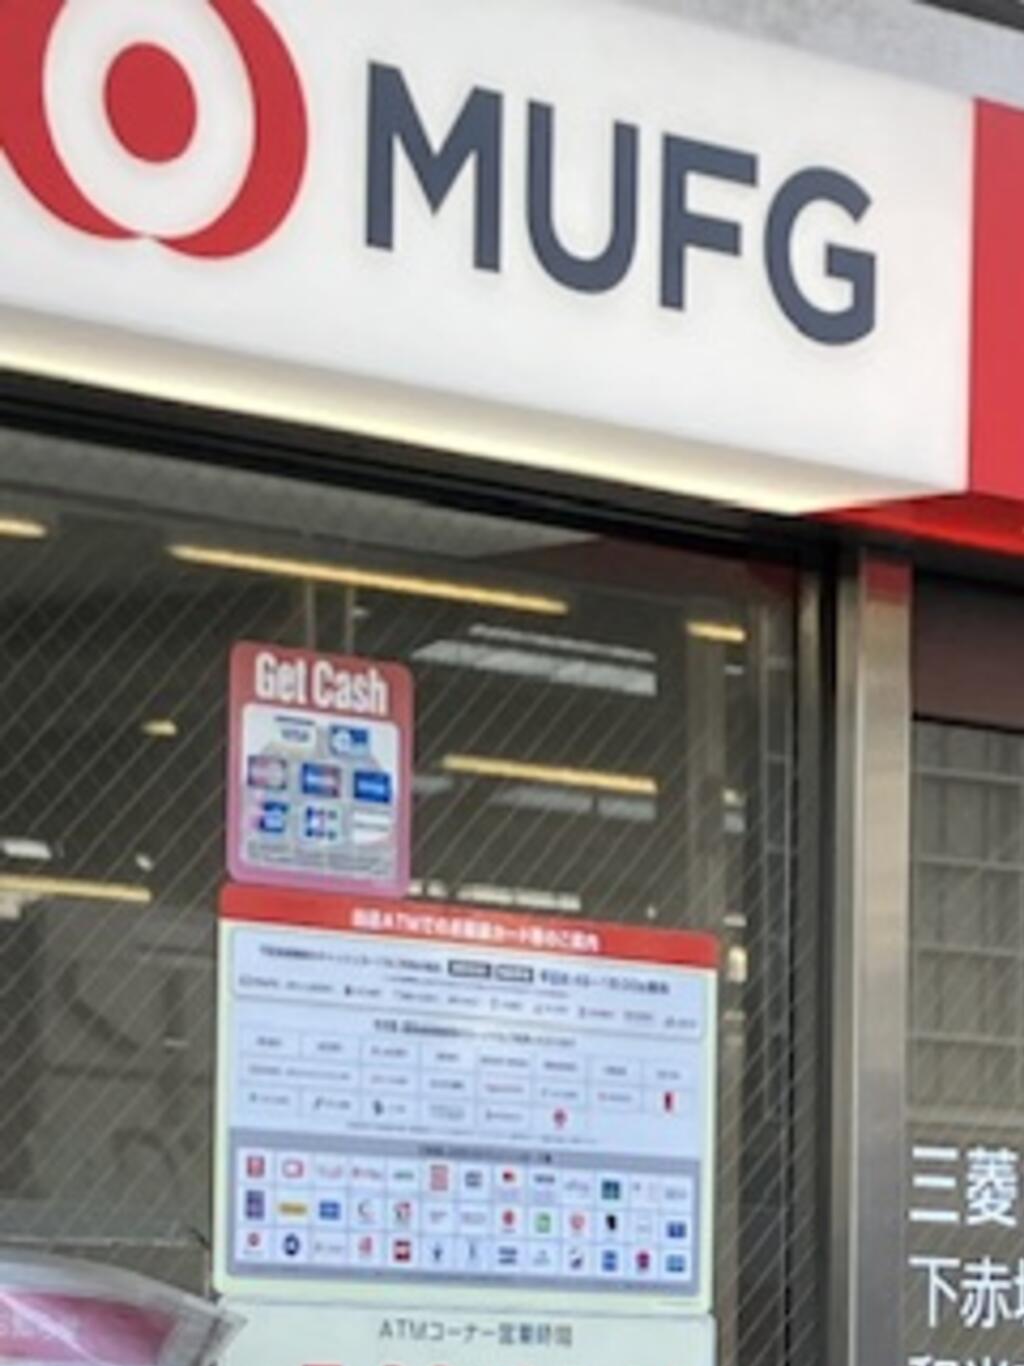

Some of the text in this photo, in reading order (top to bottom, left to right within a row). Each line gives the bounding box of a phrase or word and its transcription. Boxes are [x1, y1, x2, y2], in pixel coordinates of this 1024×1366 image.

[366, 60, 877, 346] MUFG
[254, 652, 388, 716] Get Cash
